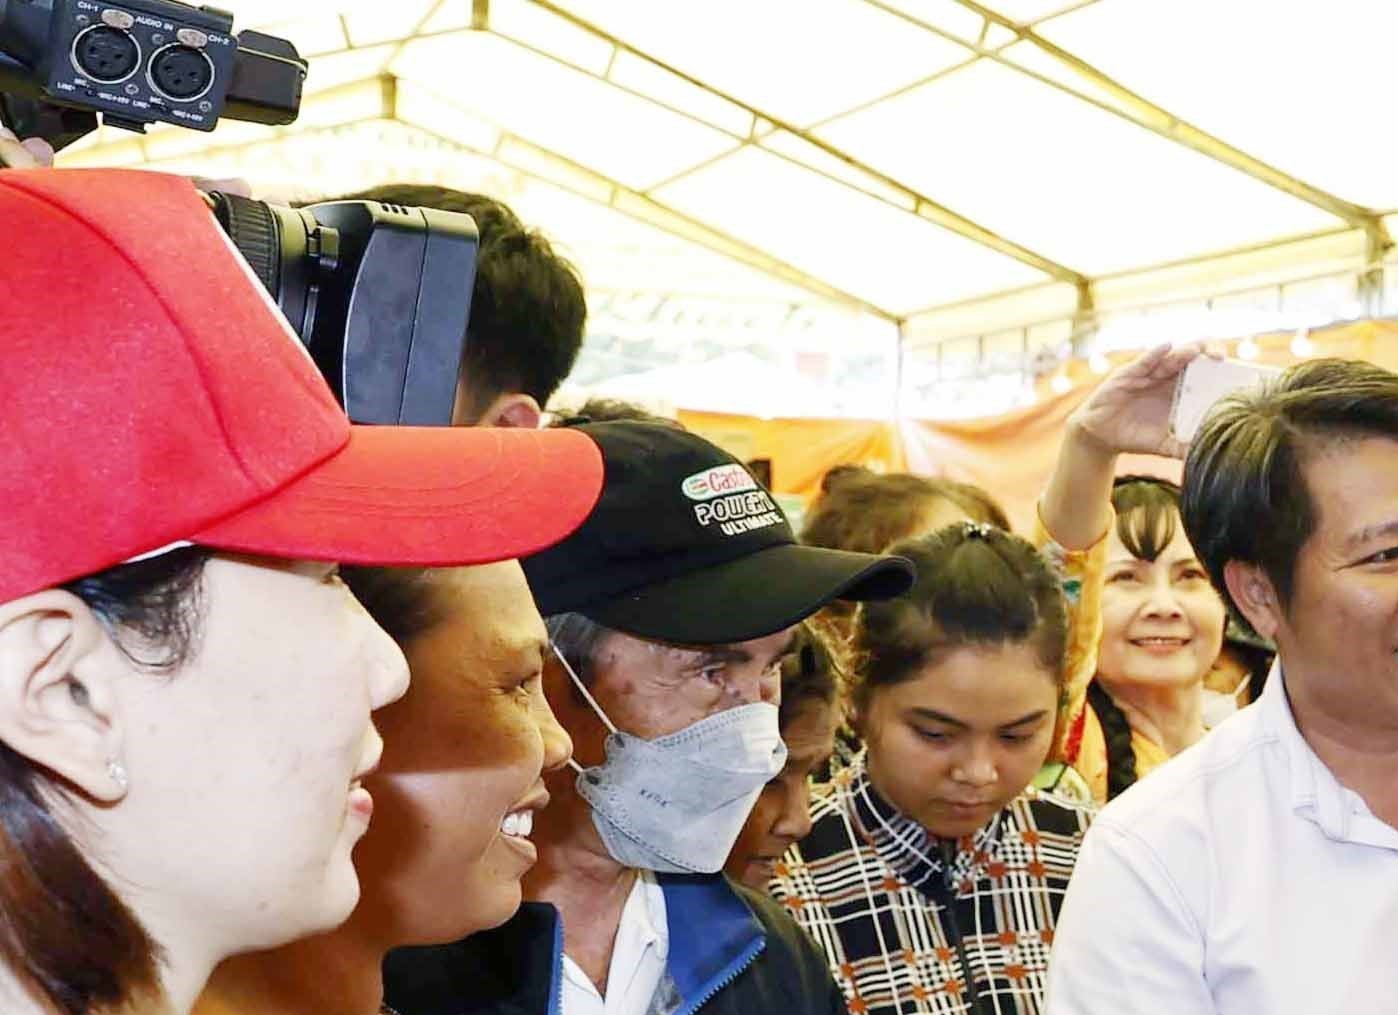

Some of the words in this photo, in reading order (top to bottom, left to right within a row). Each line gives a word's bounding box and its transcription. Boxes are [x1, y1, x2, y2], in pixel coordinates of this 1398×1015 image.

[77, 1, 99, 12] CH-1
[135, 16, 162, 28] AUDIO
[163, 22, 174, 31] IN
